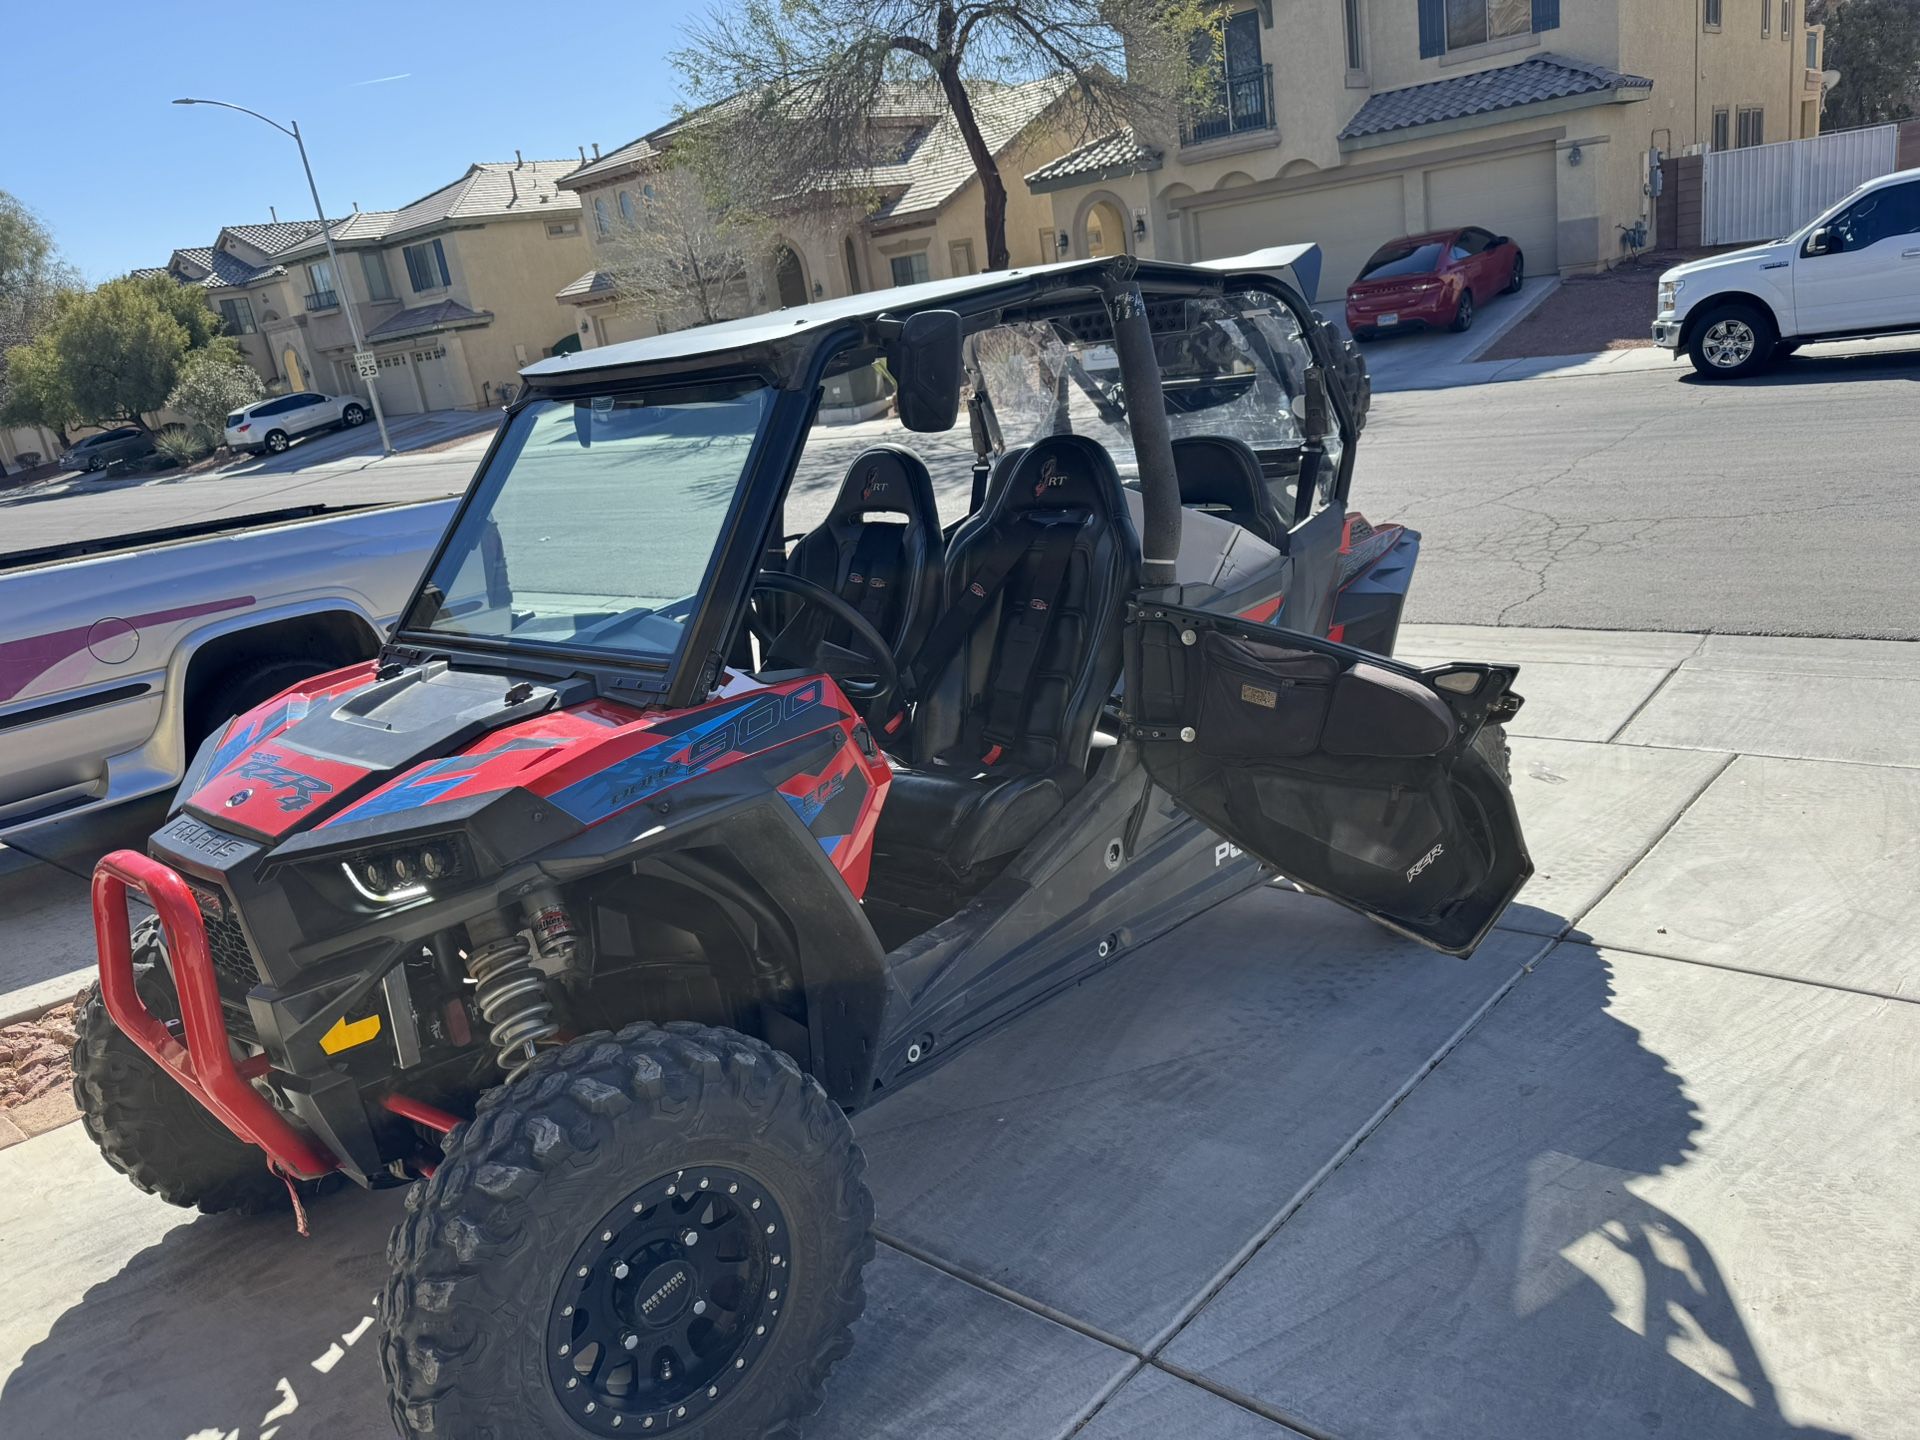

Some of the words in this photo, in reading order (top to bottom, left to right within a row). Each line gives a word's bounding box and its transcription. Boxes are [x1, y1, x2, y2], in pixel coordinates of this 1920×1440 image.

[360, 365, 377, 376] 25
[873, 483, 888, 491] RT
[1049, 476, 1068, 486] RT
[686, 680, 824, 777] 900
[224, 761, 333, 801] RZR
[1406, 843, 1444, 883] RZR
[642, 1271, 684, 1310] METHOD
